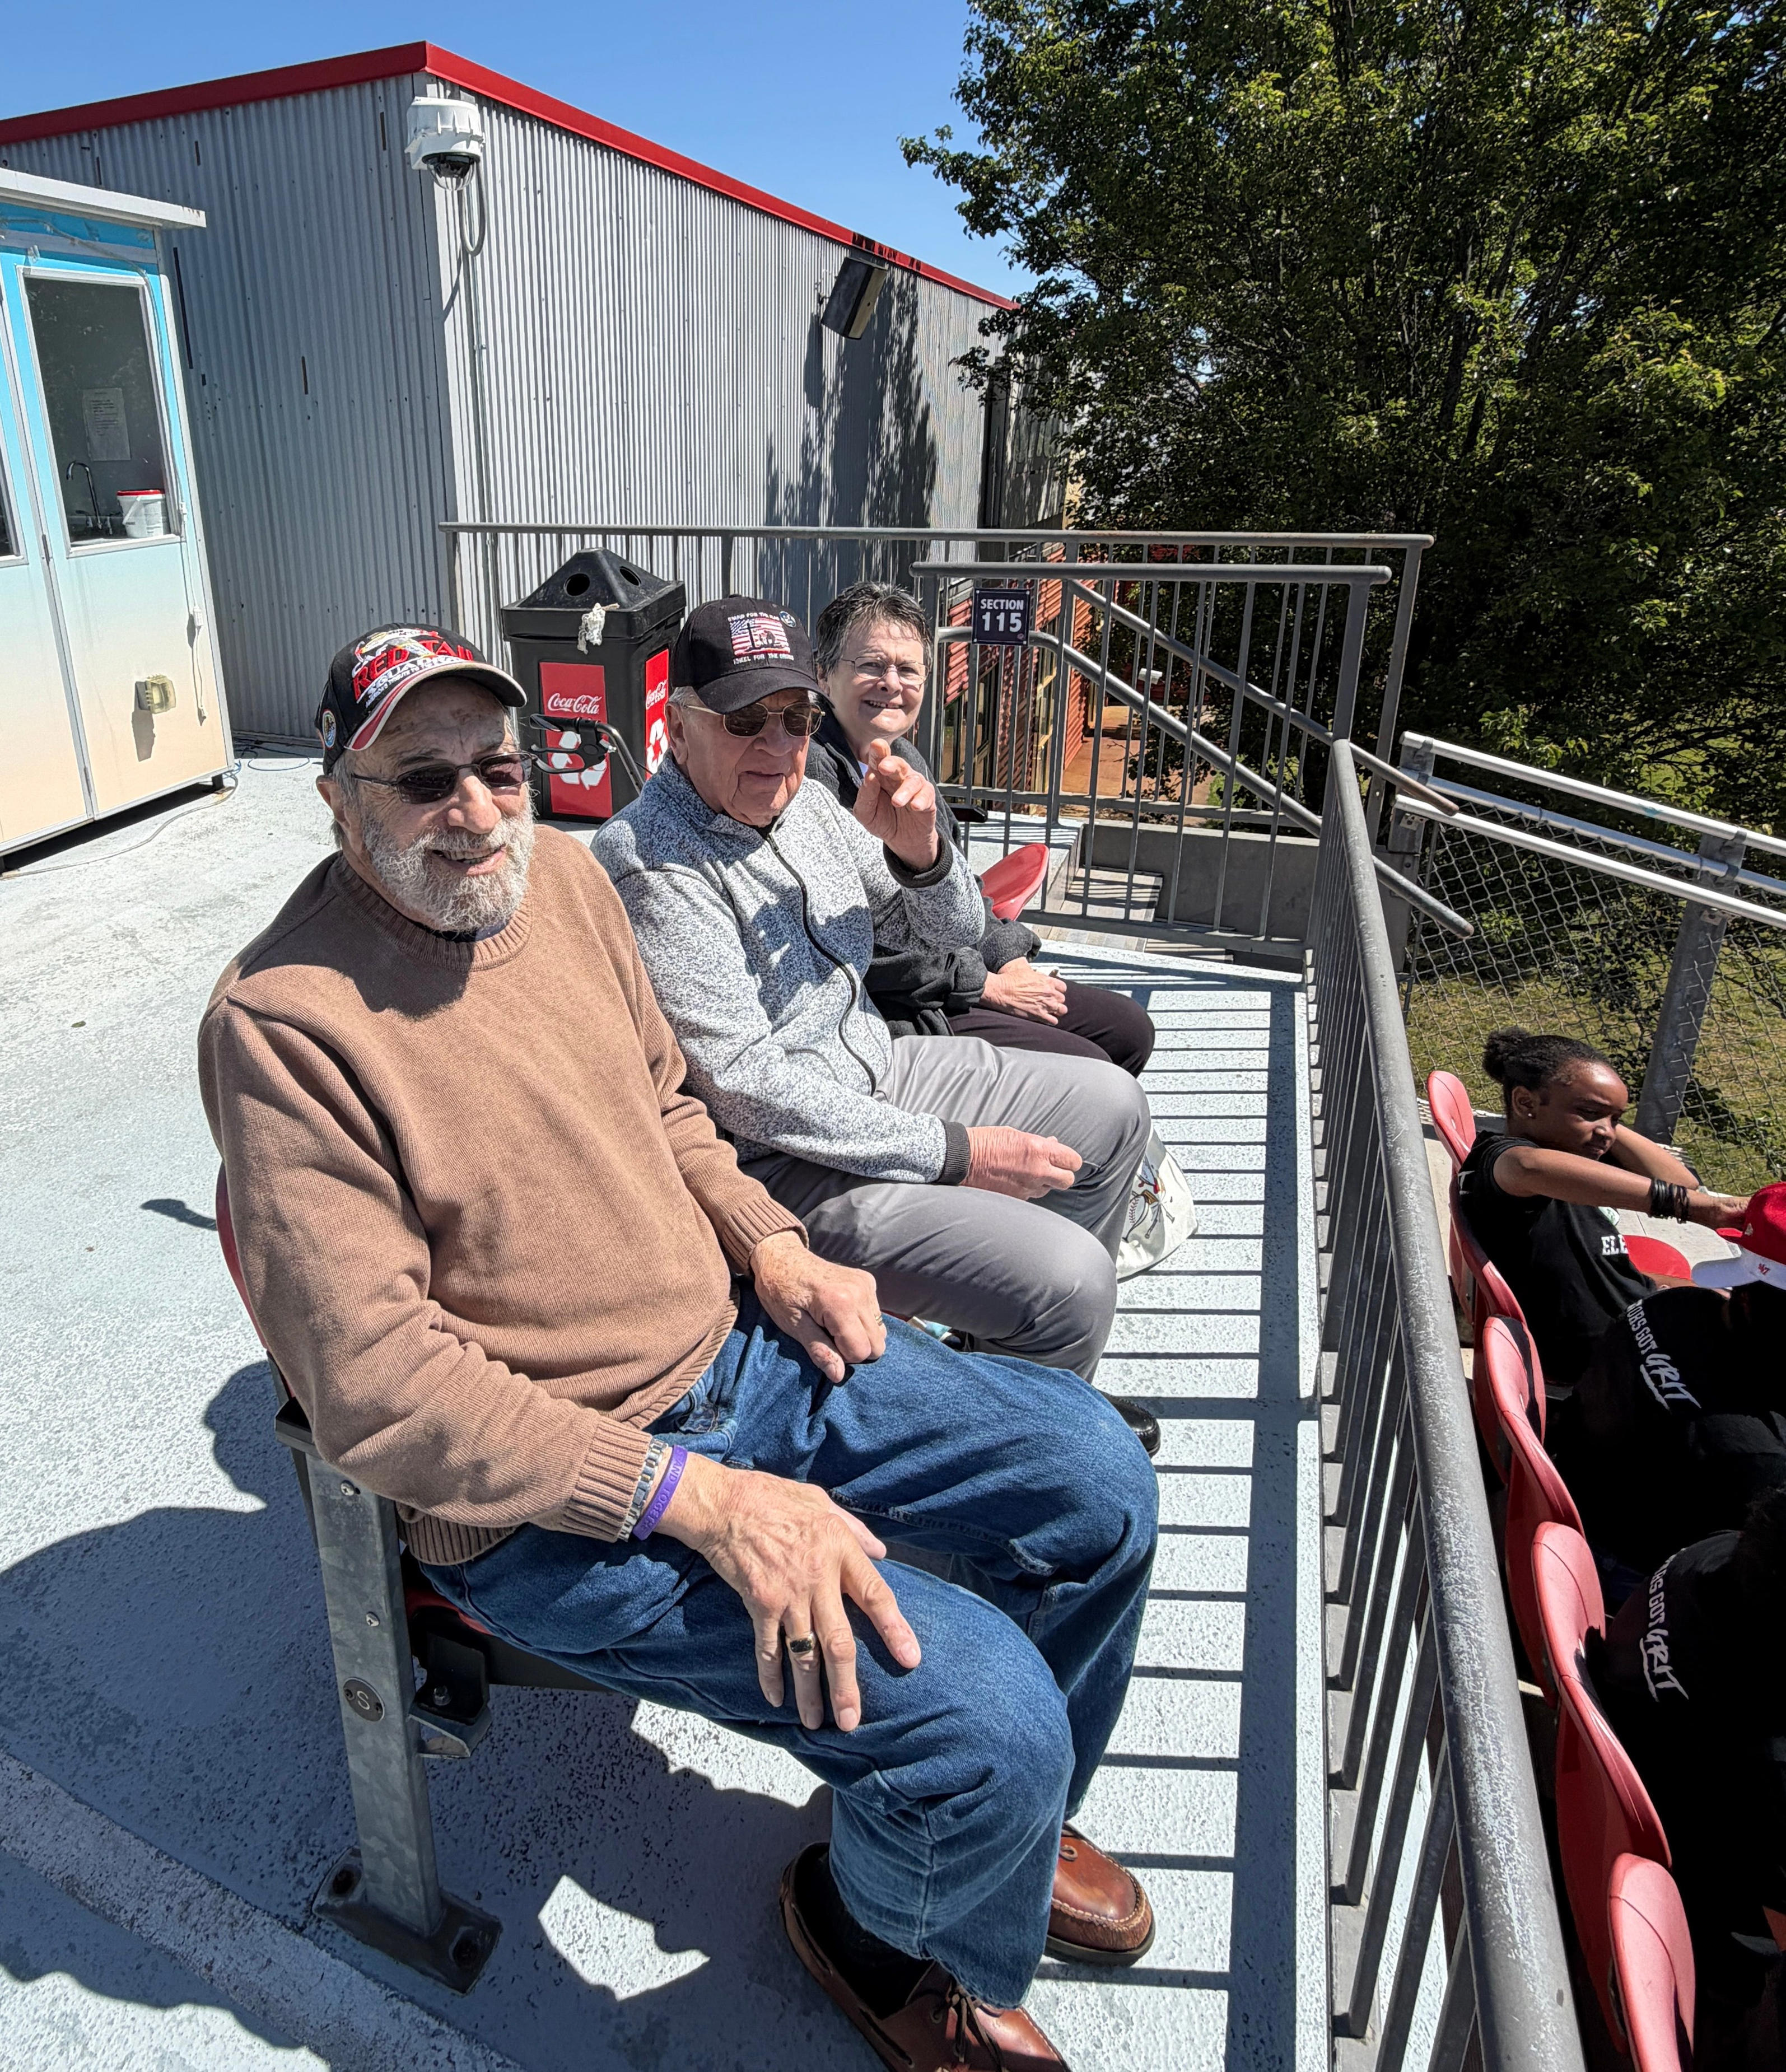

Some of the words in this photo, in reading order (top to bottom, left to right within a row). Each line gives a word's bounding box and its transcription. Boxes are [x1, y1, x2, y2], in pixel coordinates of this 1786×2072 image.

[980, 599, 1024, 610] SECTION
[982, 612, 1022, 632] 115
[352, 647, 410, 700] RED
[1635, 1326, 1658, 1355] GOT
[1648, 1592, 1665, 1628] GOT
[357, 1690, 370, 1710] S
